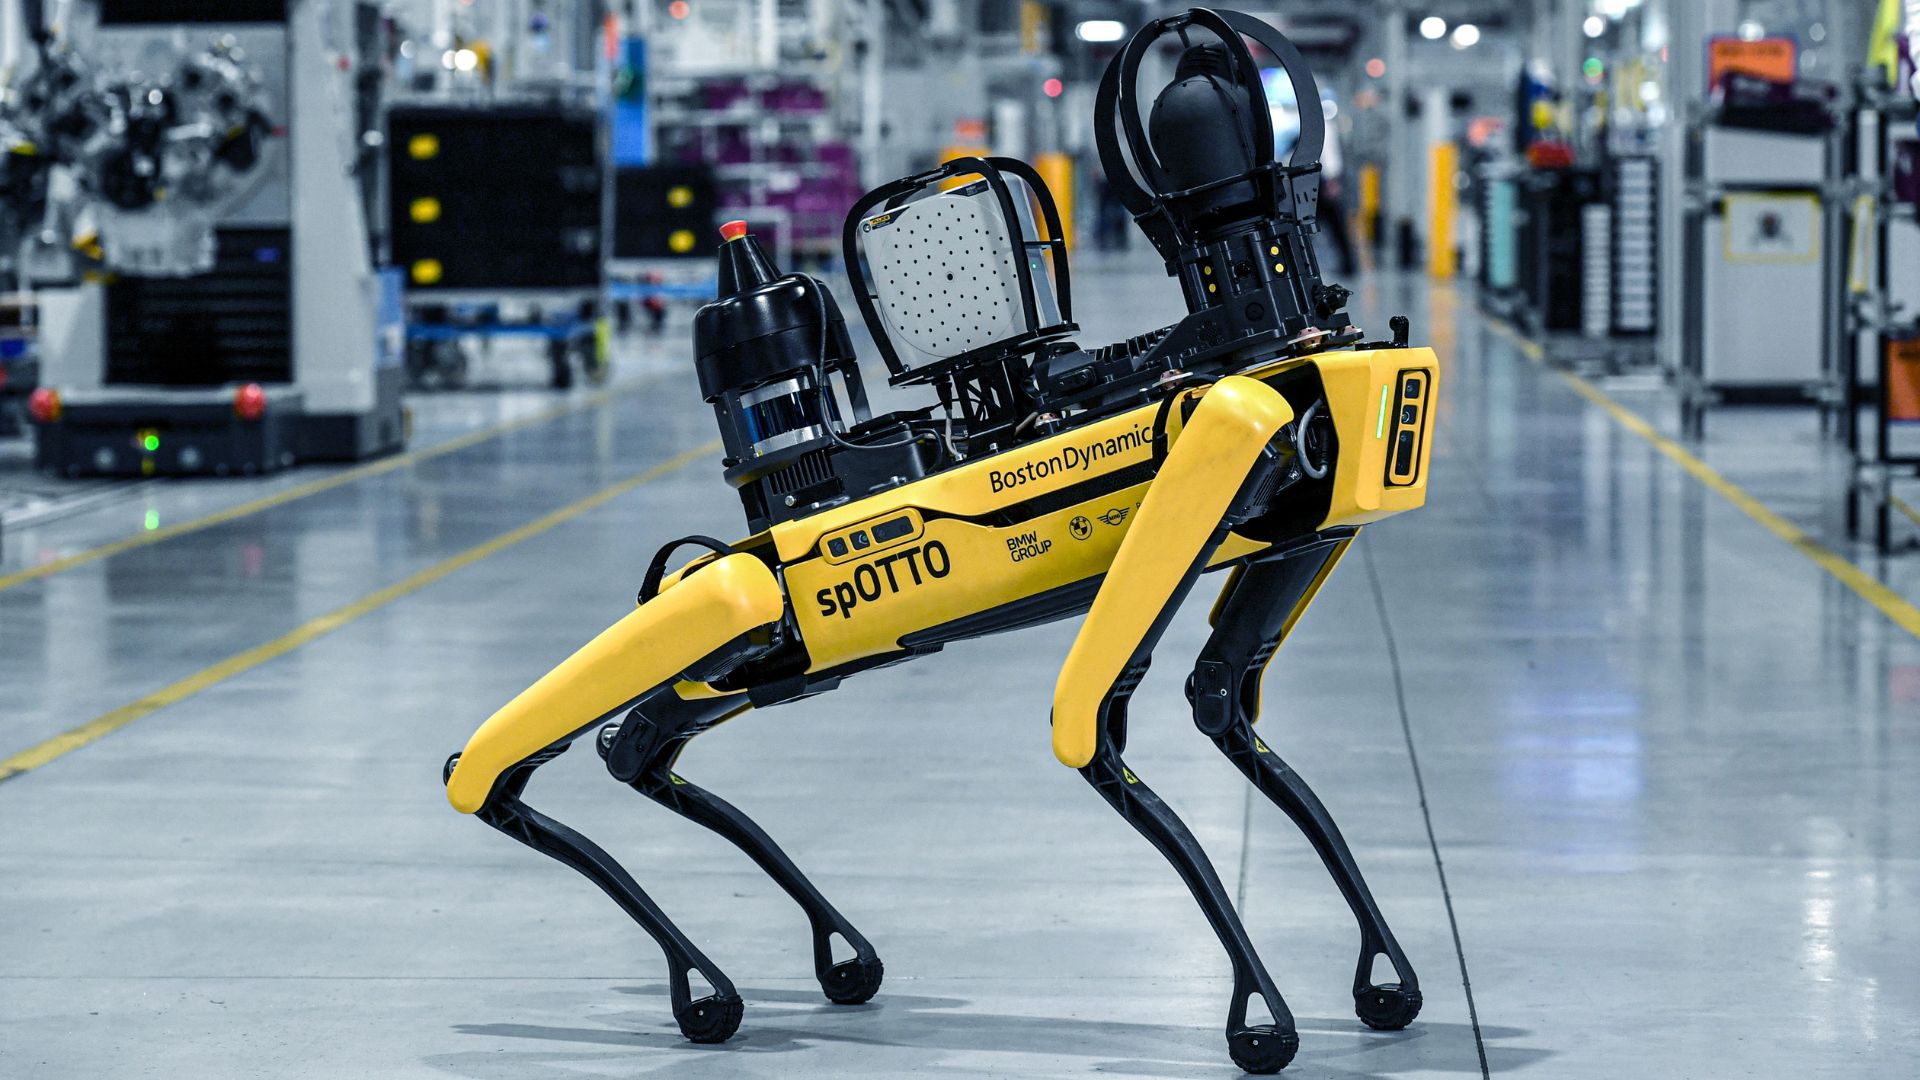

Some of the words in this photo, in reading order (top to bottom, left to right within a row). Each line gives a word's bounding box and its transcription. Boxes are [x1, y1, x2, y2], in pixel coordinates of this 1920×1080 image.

[989, 423, 1154, 494] BostonDynamic
[1006, 531, 1037, 551] BMW
[1011, 540, 1052, 562] GROUP
[816, 540, 951, 619] spOTTO
